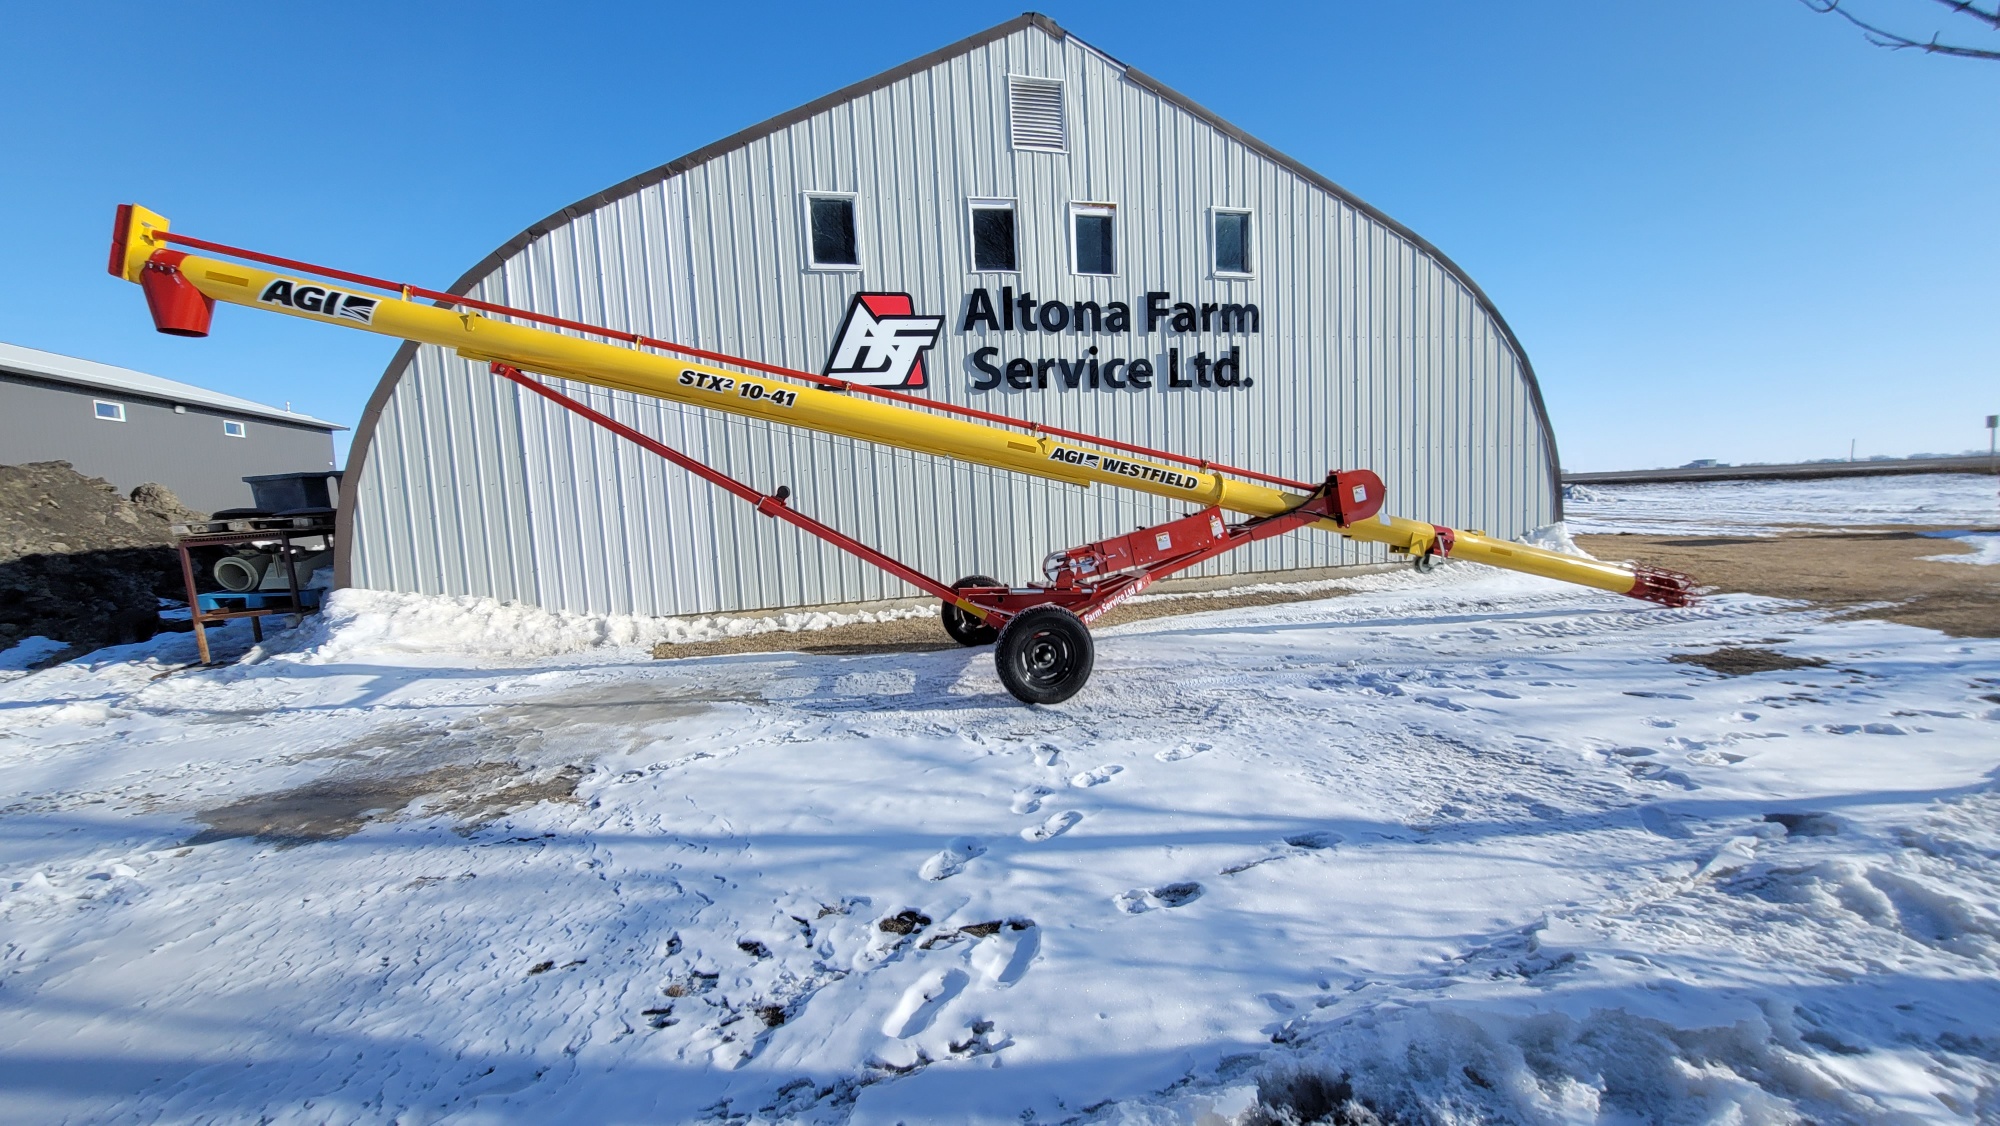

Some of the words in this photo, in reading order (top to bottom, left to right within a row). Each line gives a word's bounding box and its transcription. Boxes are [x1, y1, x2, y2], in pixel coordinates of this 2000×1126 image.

[261, 279, 342, 316] AGI
[963, 286, 1131, 333] Altona
[1147, 291, 1260, 333] Farm
[973, 345, 1154, 391] Service
[1169, 345, 1254, 388] Ltd.
[741, 383, 797, 407] 10-41
[1050, 447, 1085, 465] AGI
[1102, 457, 1198, 489] WESTFIELD
[1084, 607, 1103, 624] Farm
[1101, 594, 1126, 613] Service
[1124, 585, 1136, 599] Ltd
